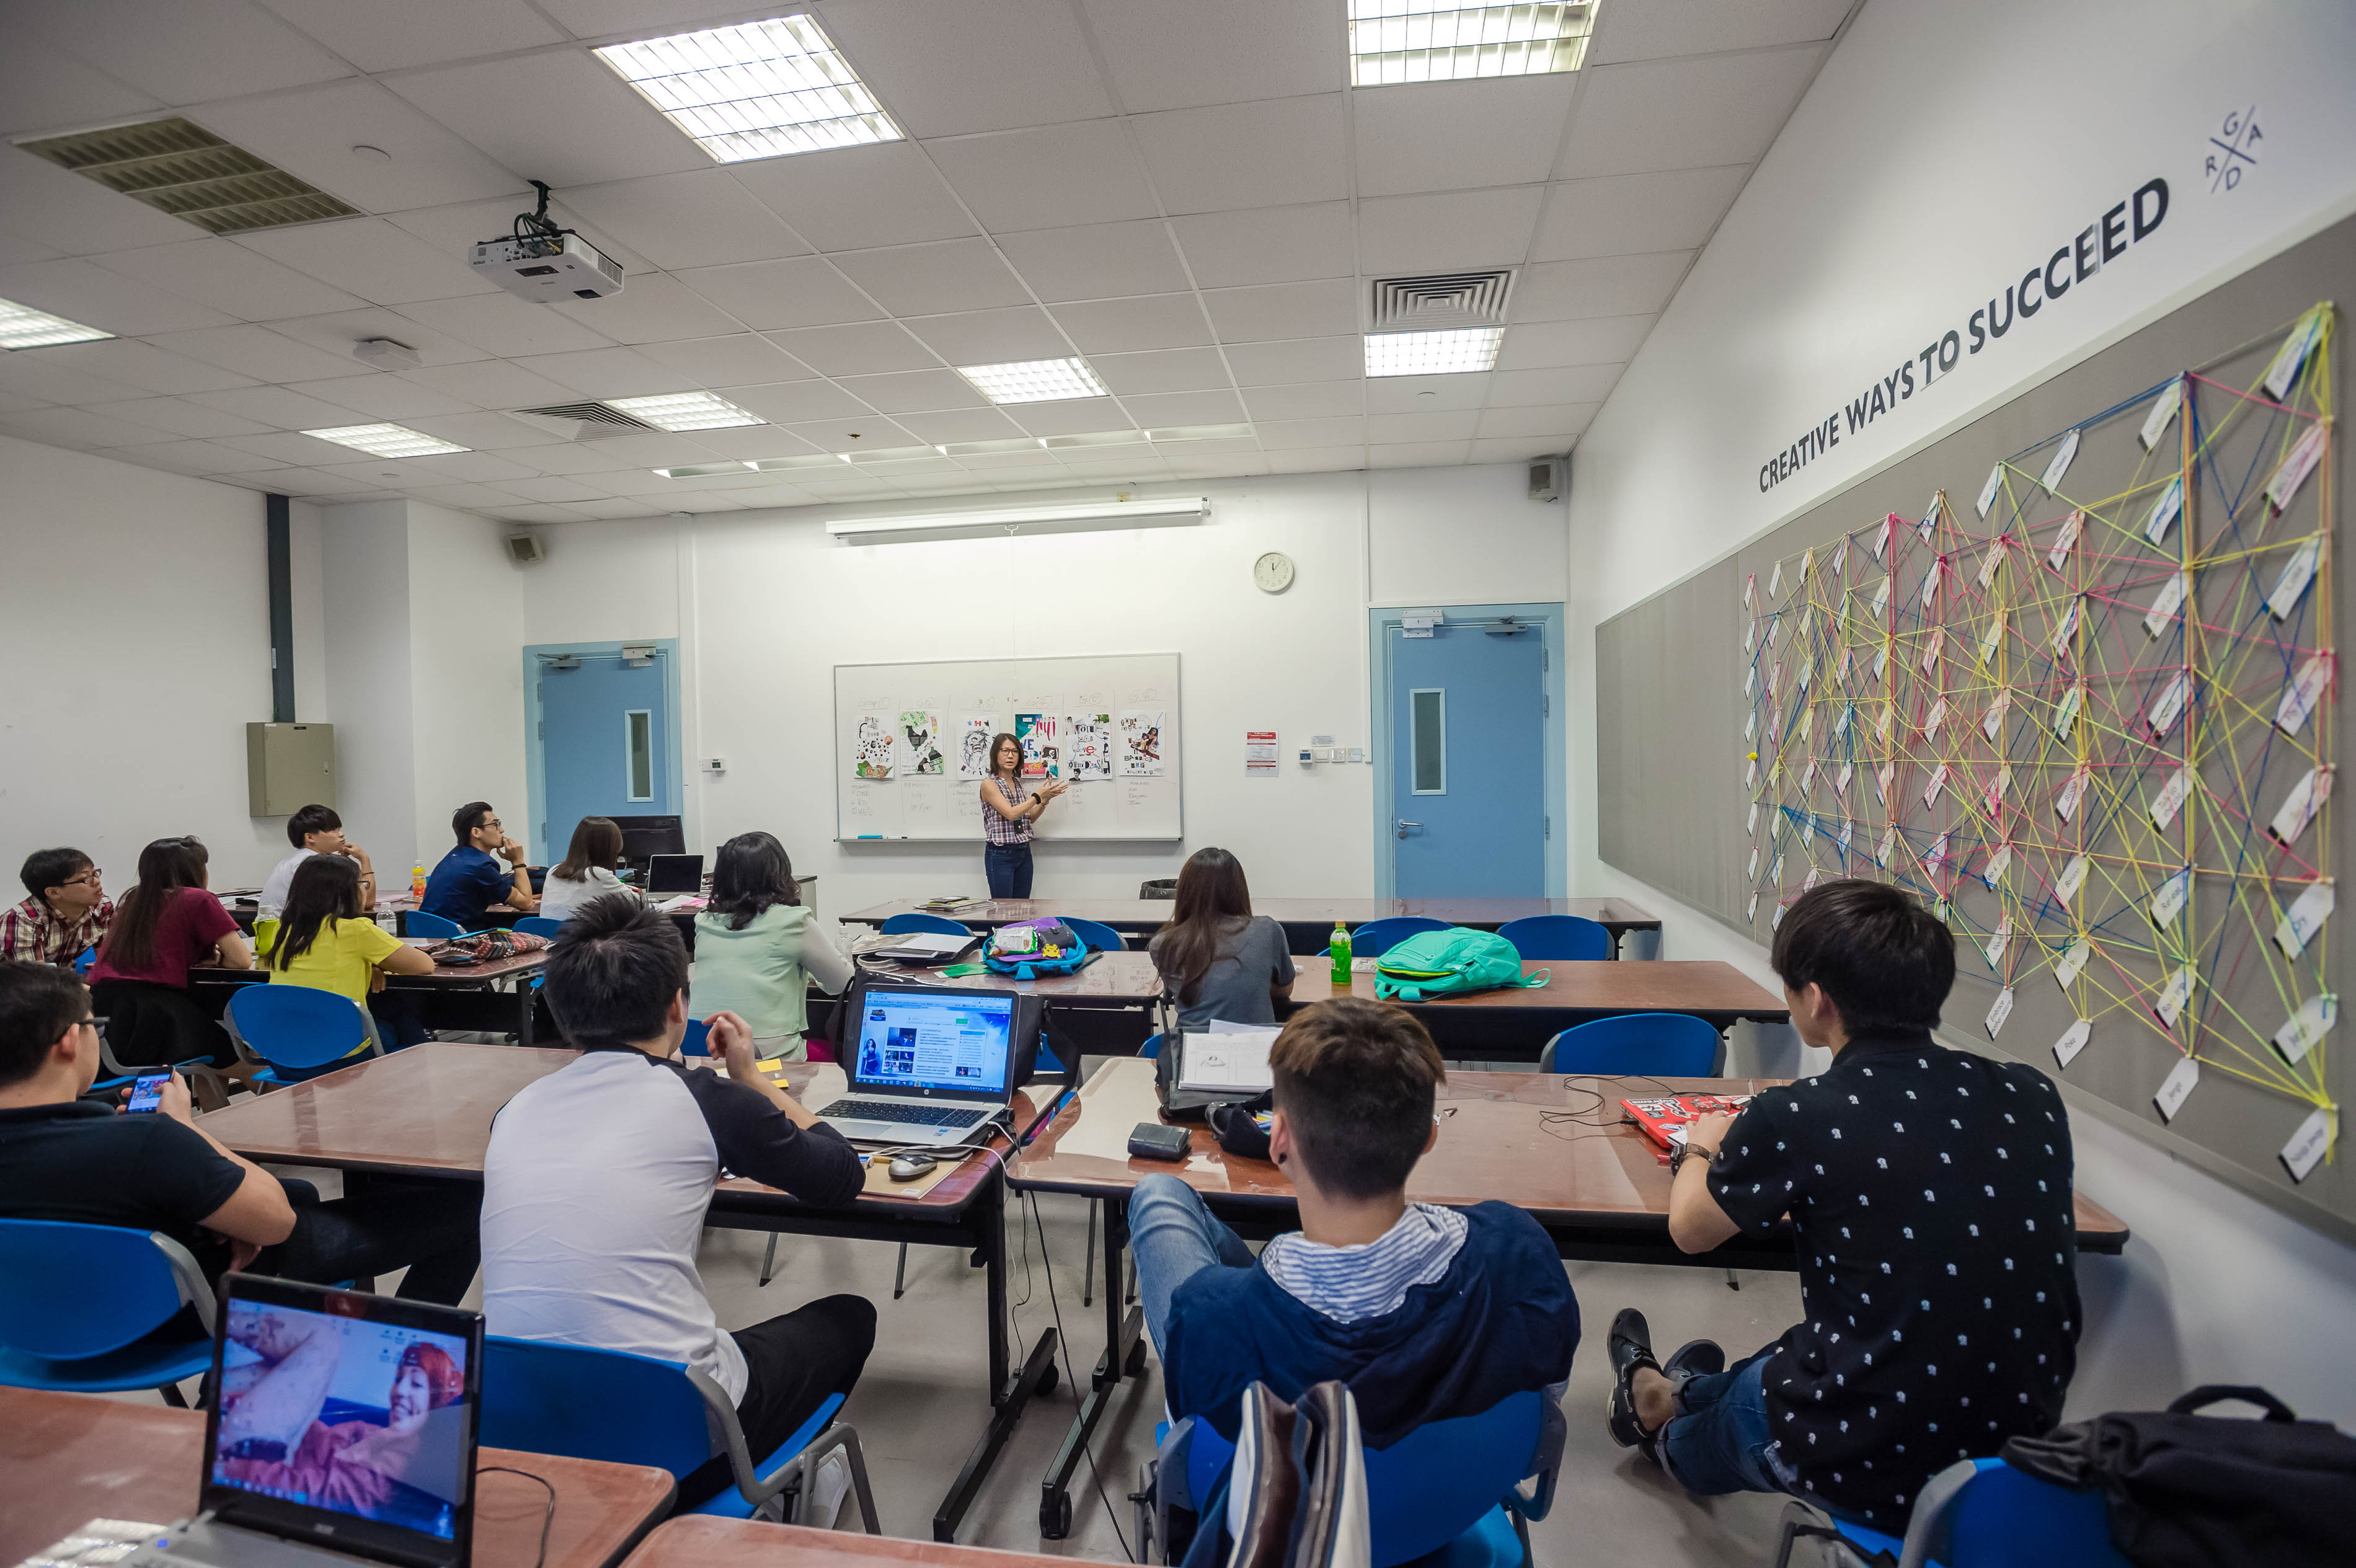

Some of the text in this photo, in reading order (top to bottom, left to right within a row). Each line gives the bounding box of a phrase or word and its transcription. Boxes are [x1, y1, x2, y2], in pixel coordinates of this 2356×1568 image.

[2223, 111, 2238, 136] G
[2246, 123, 2262, 148] A
[2205, 156, 2217, 178] R
[2226, 167, 2241, 191] D
[1760, 177, 2169, 493] CREATIVE WAYS TO SUCCEED
